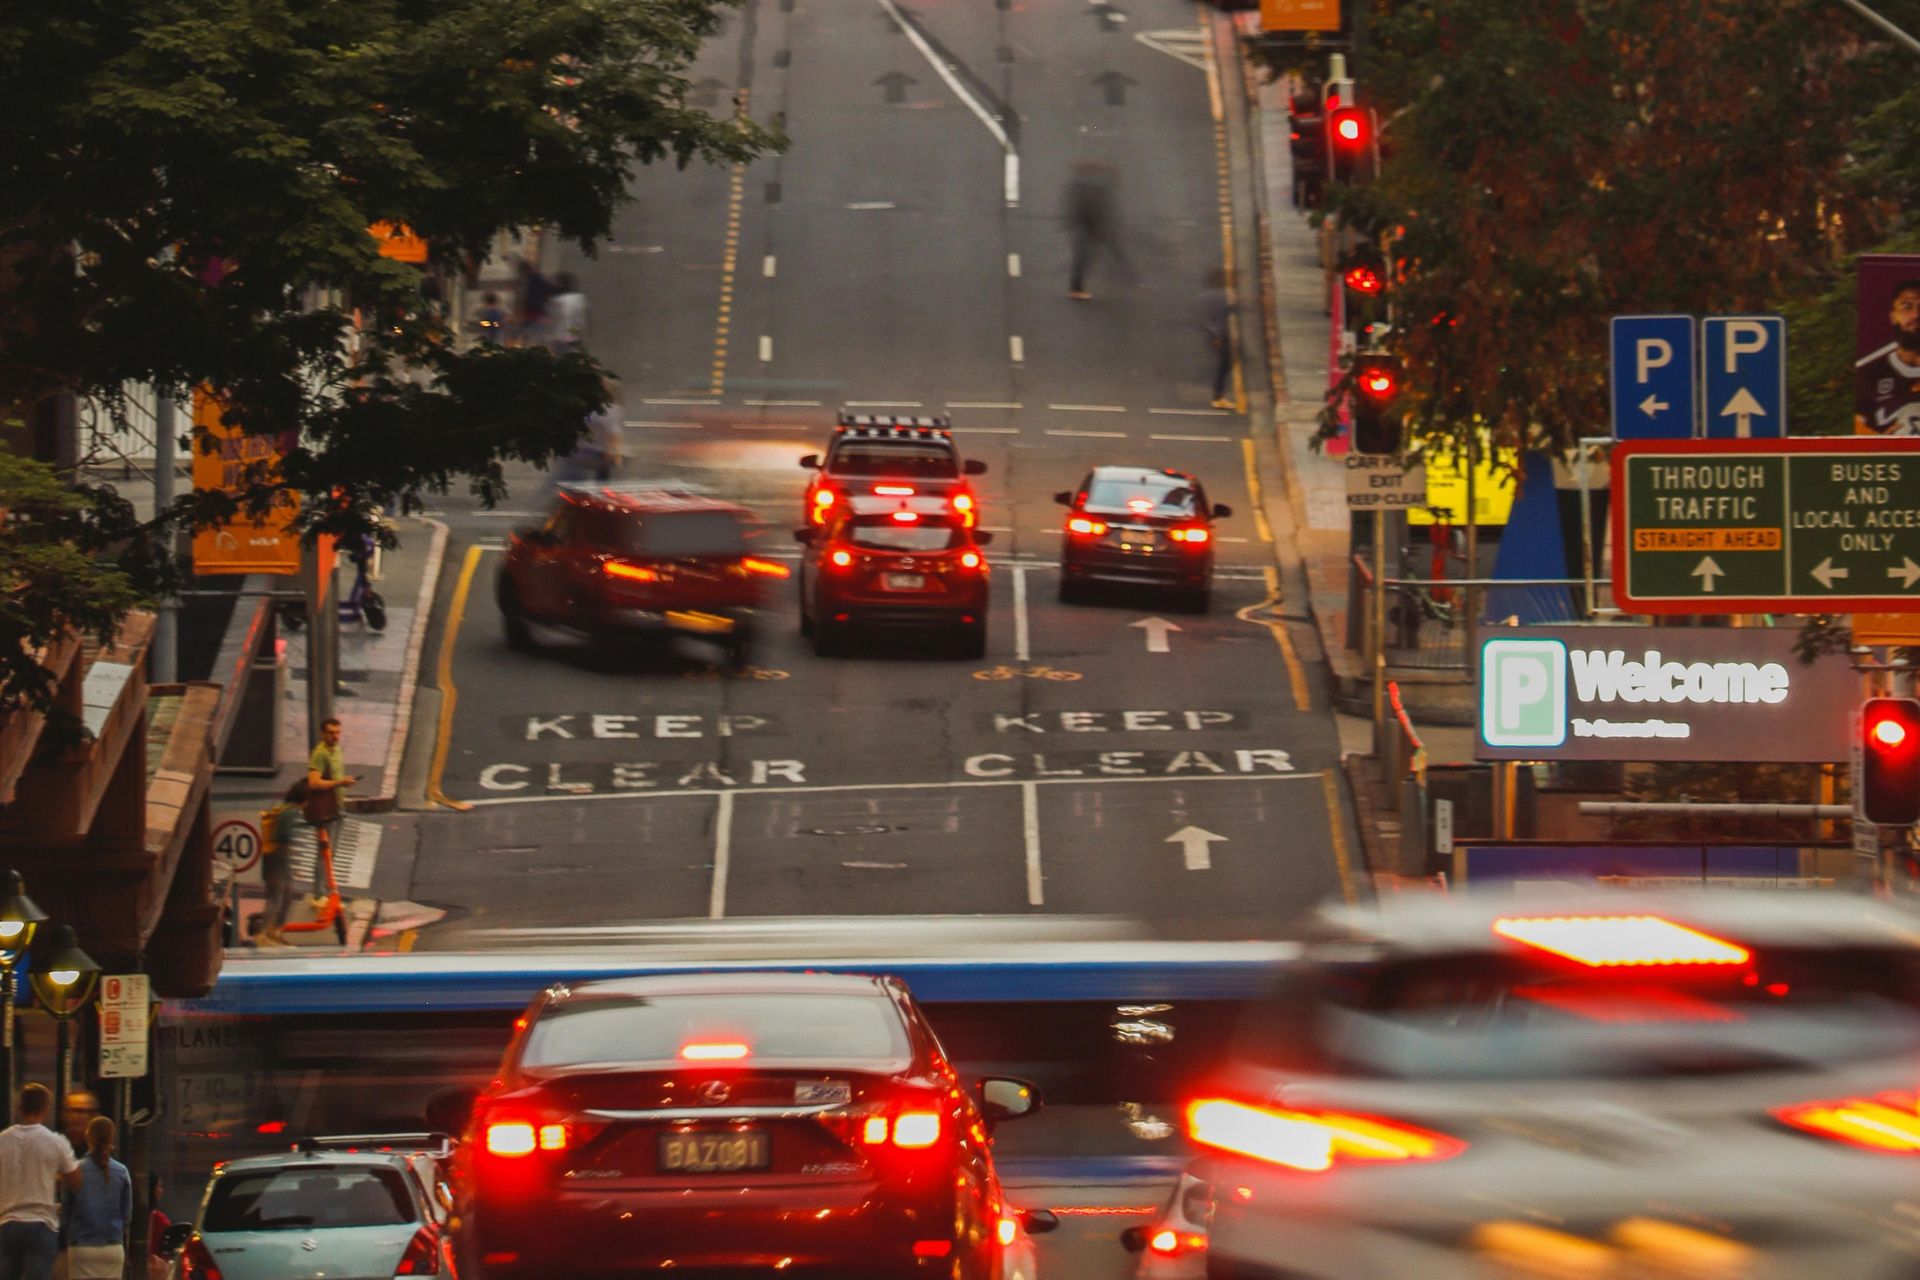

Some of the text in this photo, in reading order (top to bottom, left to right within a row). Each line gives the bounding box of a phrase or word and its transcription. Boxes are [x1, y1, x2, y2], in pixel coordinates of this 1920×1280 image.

[1724, 321, 1769, 373] P
[1637, 338, 1673, 384] P
[1345, 456, 1378, 469] CAR
[1832, 464, 1901, 481] BUSES
[1369, 474, 1403, 488] EXIT
[1649, 466, 1765, 489] THROUGH
[1347, 493, 1380, 505] KEEP
[1844, 487, 1890, 504] AND
[1655, 497, 1757, 520] TRAFFIC
[1793, 510, 1855, 528] LOCAL
[1639, 531, 1777, 548] STRAIGHT AHEAD
[1841, 533, 1894, 551] ONLY
[1570, 650, 1789, 703] Welcome
[525, 714, 769, 741] KEEP
[993, 711, 1235, 733] KEEP
[964, 749, 1295, 777] CLEAR
[479, 759, 807, 793] CLEAR
[215, 833, 254, 859] 40
